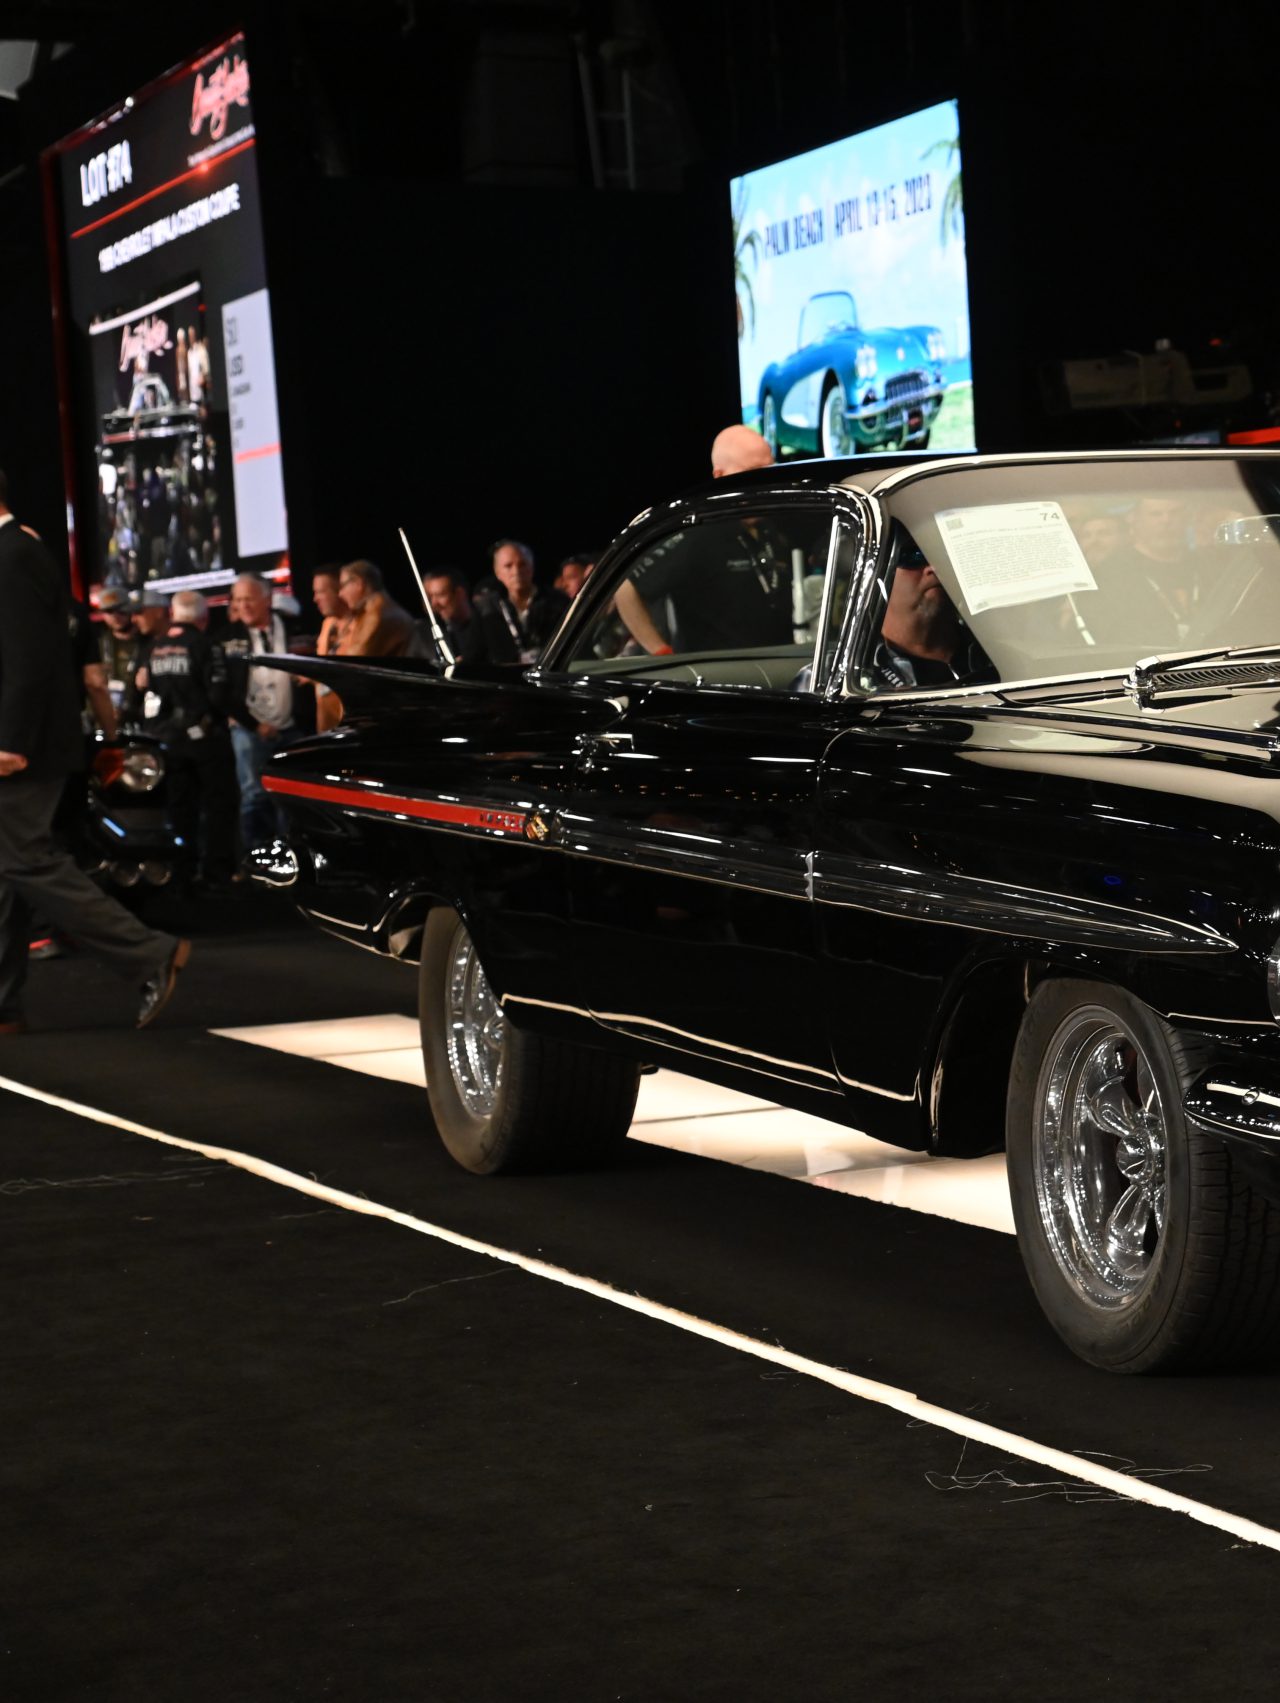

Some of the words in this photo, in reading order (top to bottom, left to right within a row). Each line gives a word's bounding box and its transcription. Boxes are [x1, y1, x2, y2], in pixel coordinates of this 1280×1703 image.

[80, 151, 108, 207] LOT
[765, 220, 790, 259] PALM
[793, 208, 824, 250] BEACH
[834, 197, 863, 237] APRIL
